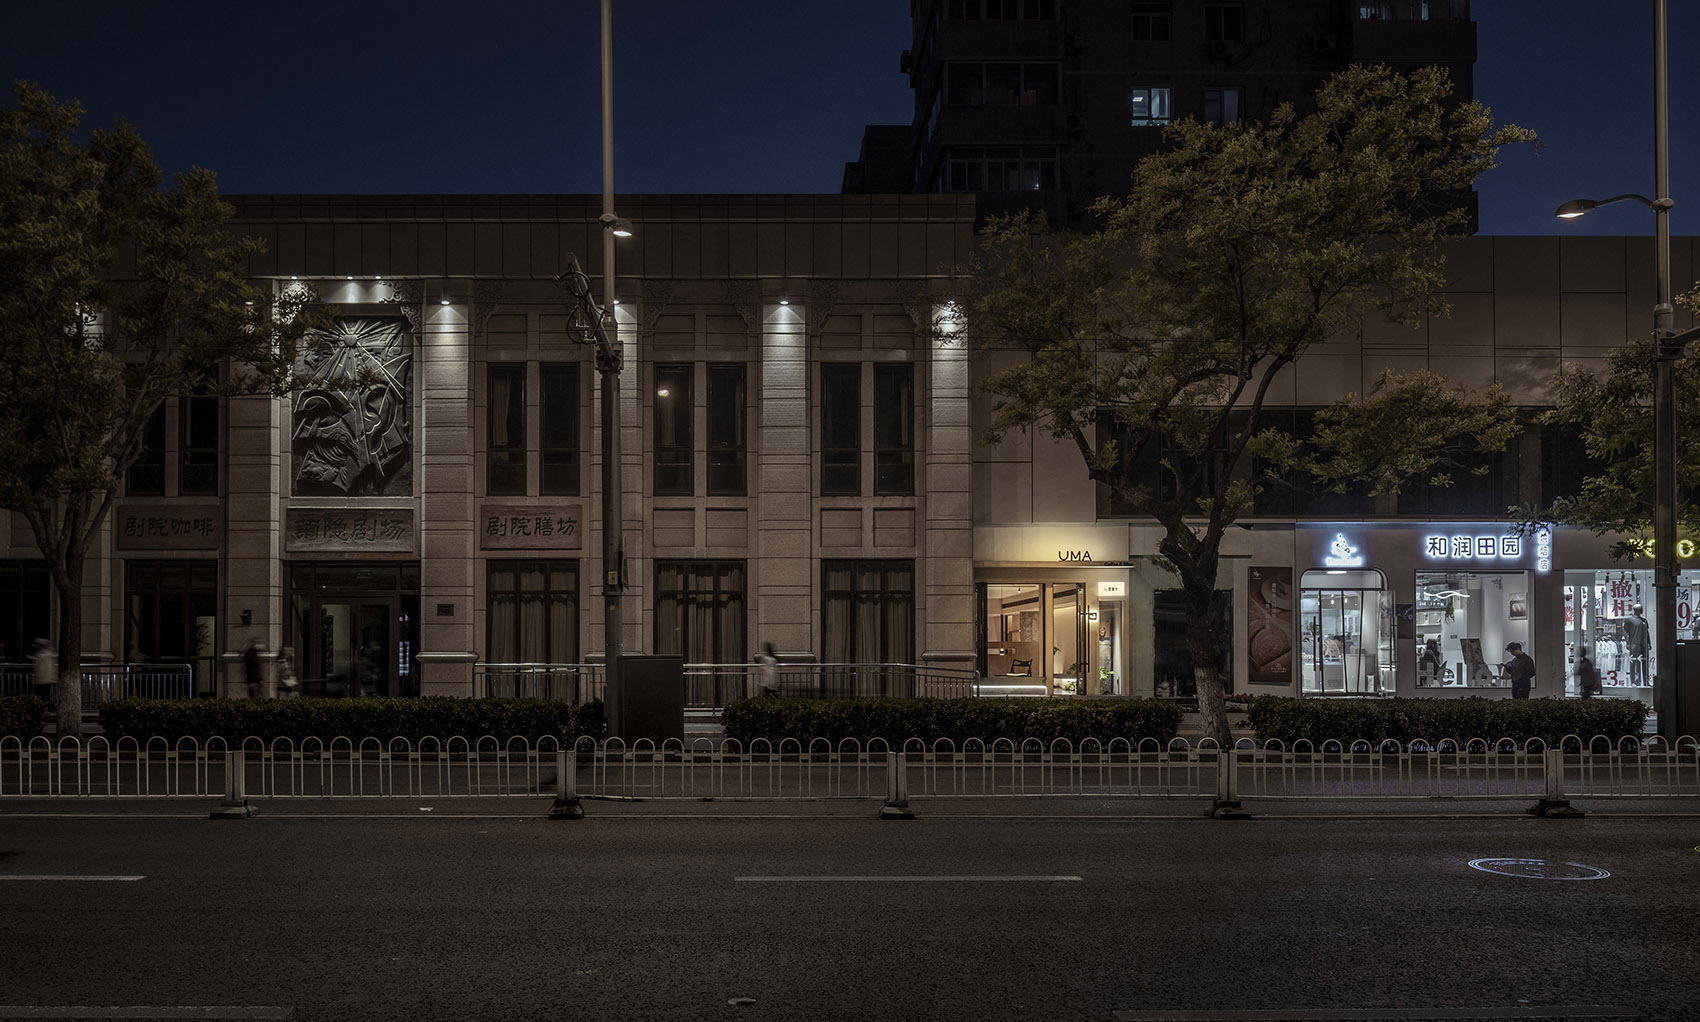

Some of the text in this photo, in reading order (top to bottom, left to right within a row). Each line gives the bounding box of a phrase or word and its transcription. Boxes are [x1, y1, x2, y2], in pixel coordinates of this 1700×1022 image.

[123, 516, 215, 537] 剧院咖啡
[486, 516, 578, 537] 剧院膳坊
[1058, 550, 1092, 562] UMA
[1427, 536, 1520, 557] 和润田园
